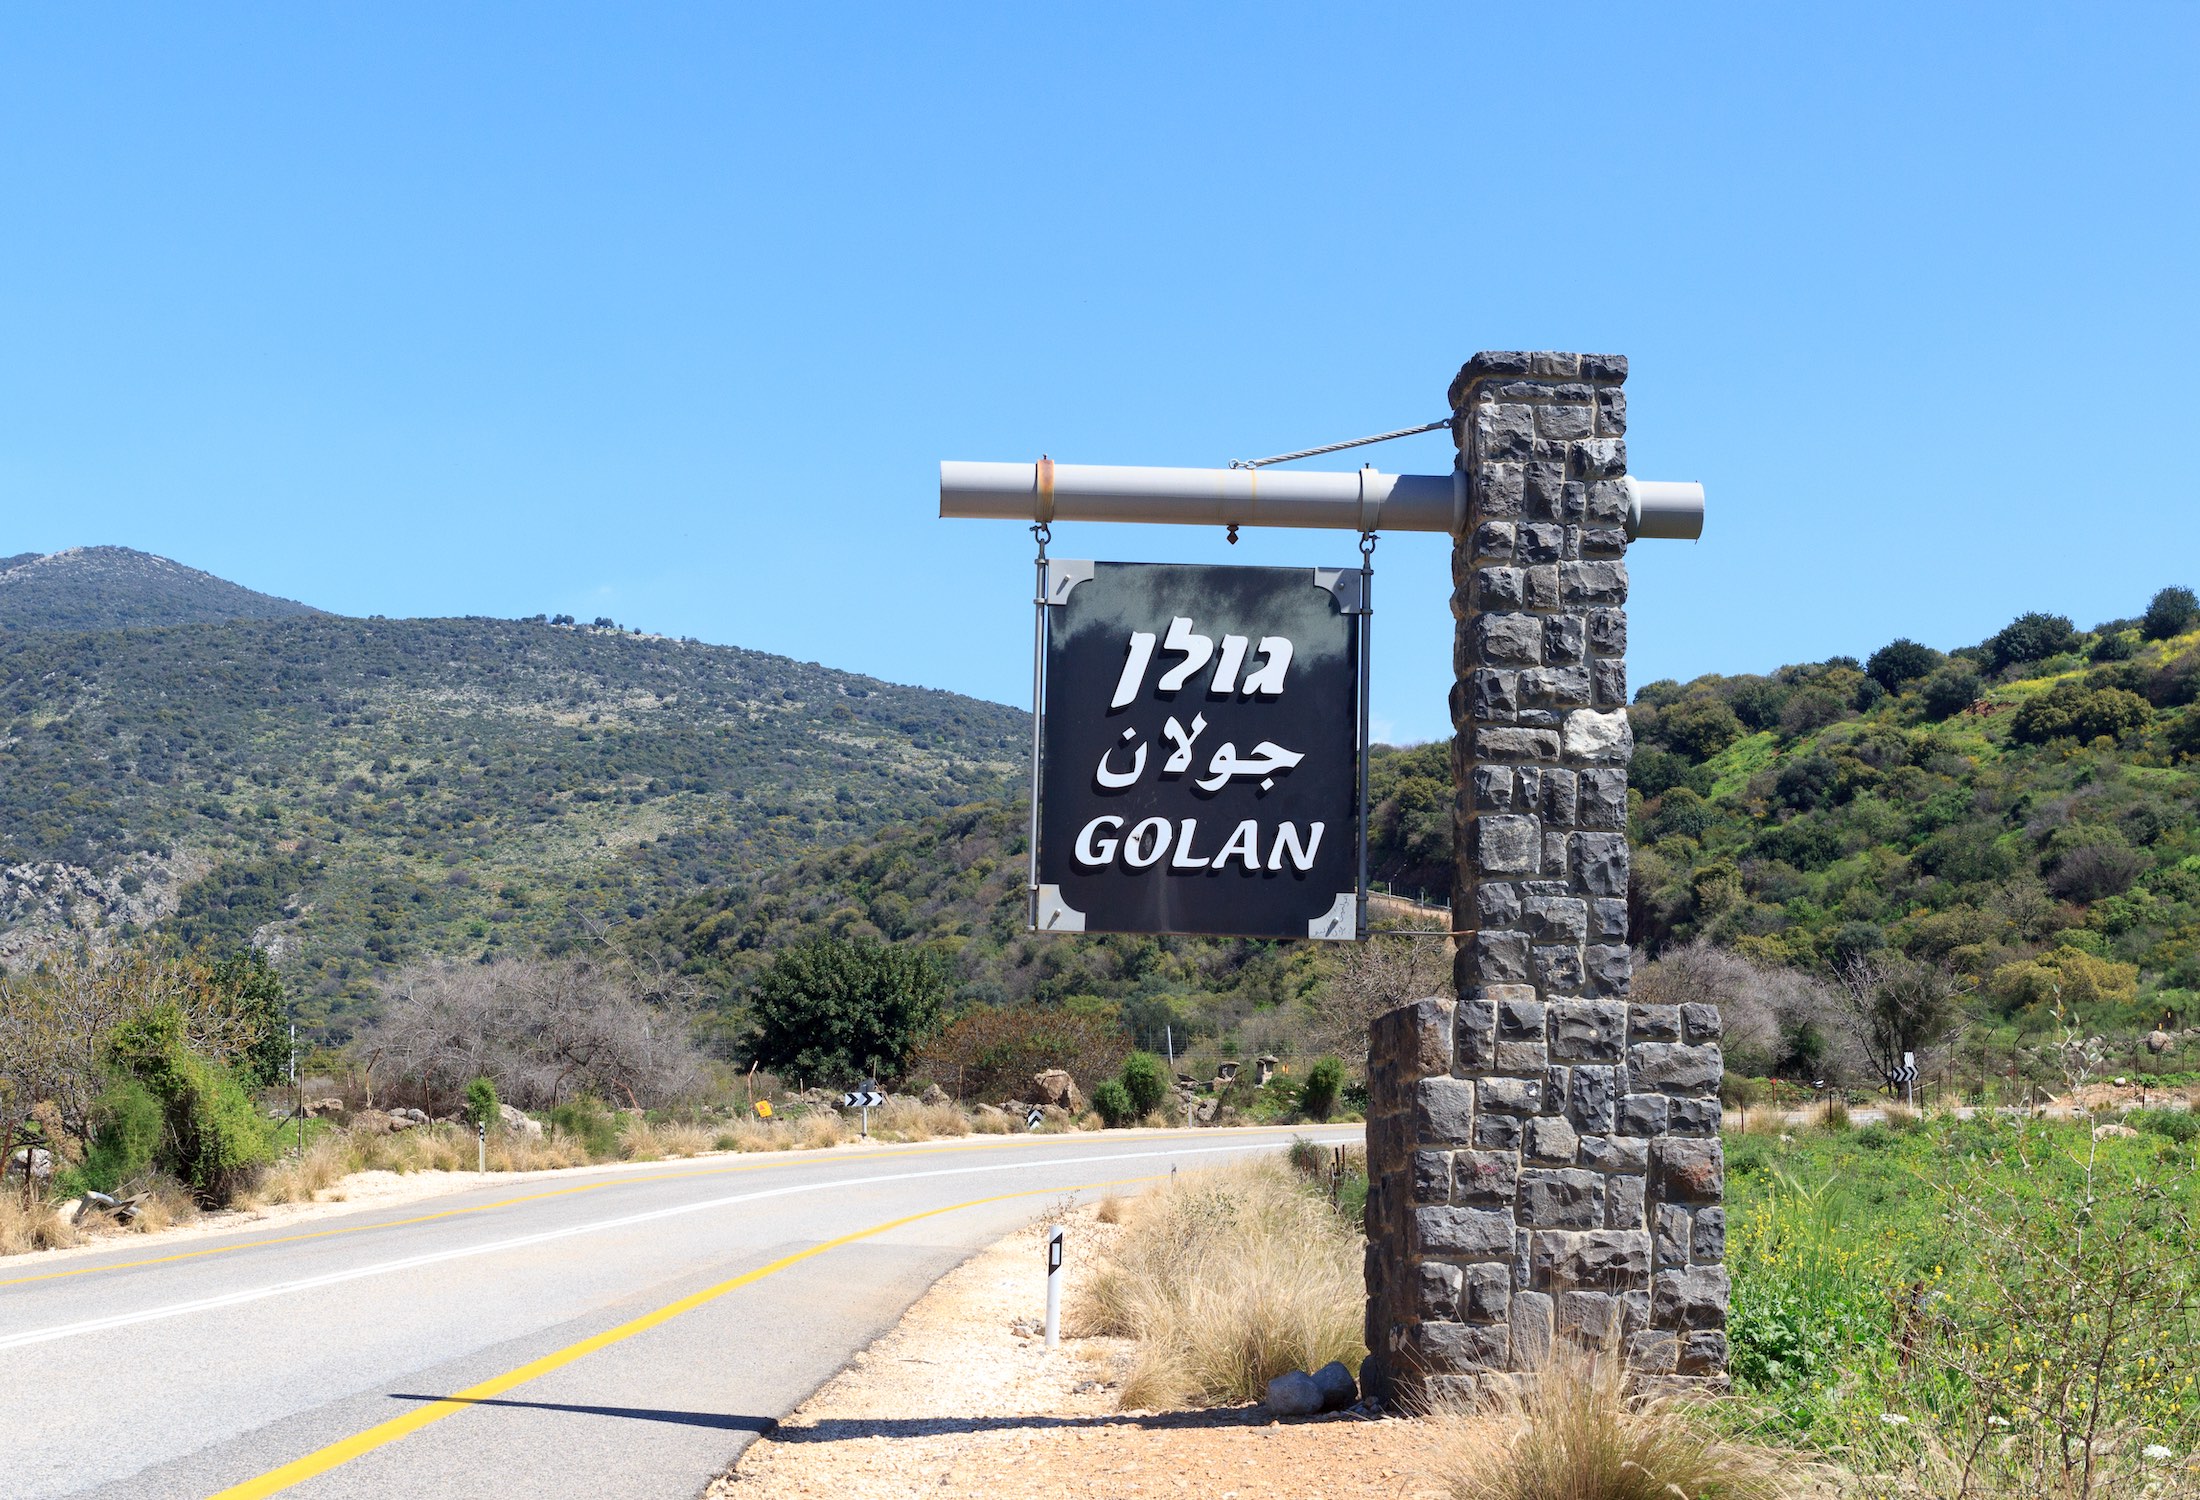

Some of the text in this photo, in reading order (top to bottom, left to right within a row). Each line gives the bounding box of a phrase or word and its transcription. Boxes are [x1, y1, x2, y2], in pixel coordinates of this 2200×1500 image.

[1110, 615, 1294, 708] גולן
[1096, 711, 1305, 791] جولان
[1074, 815, 1325, 870] GOLAN
